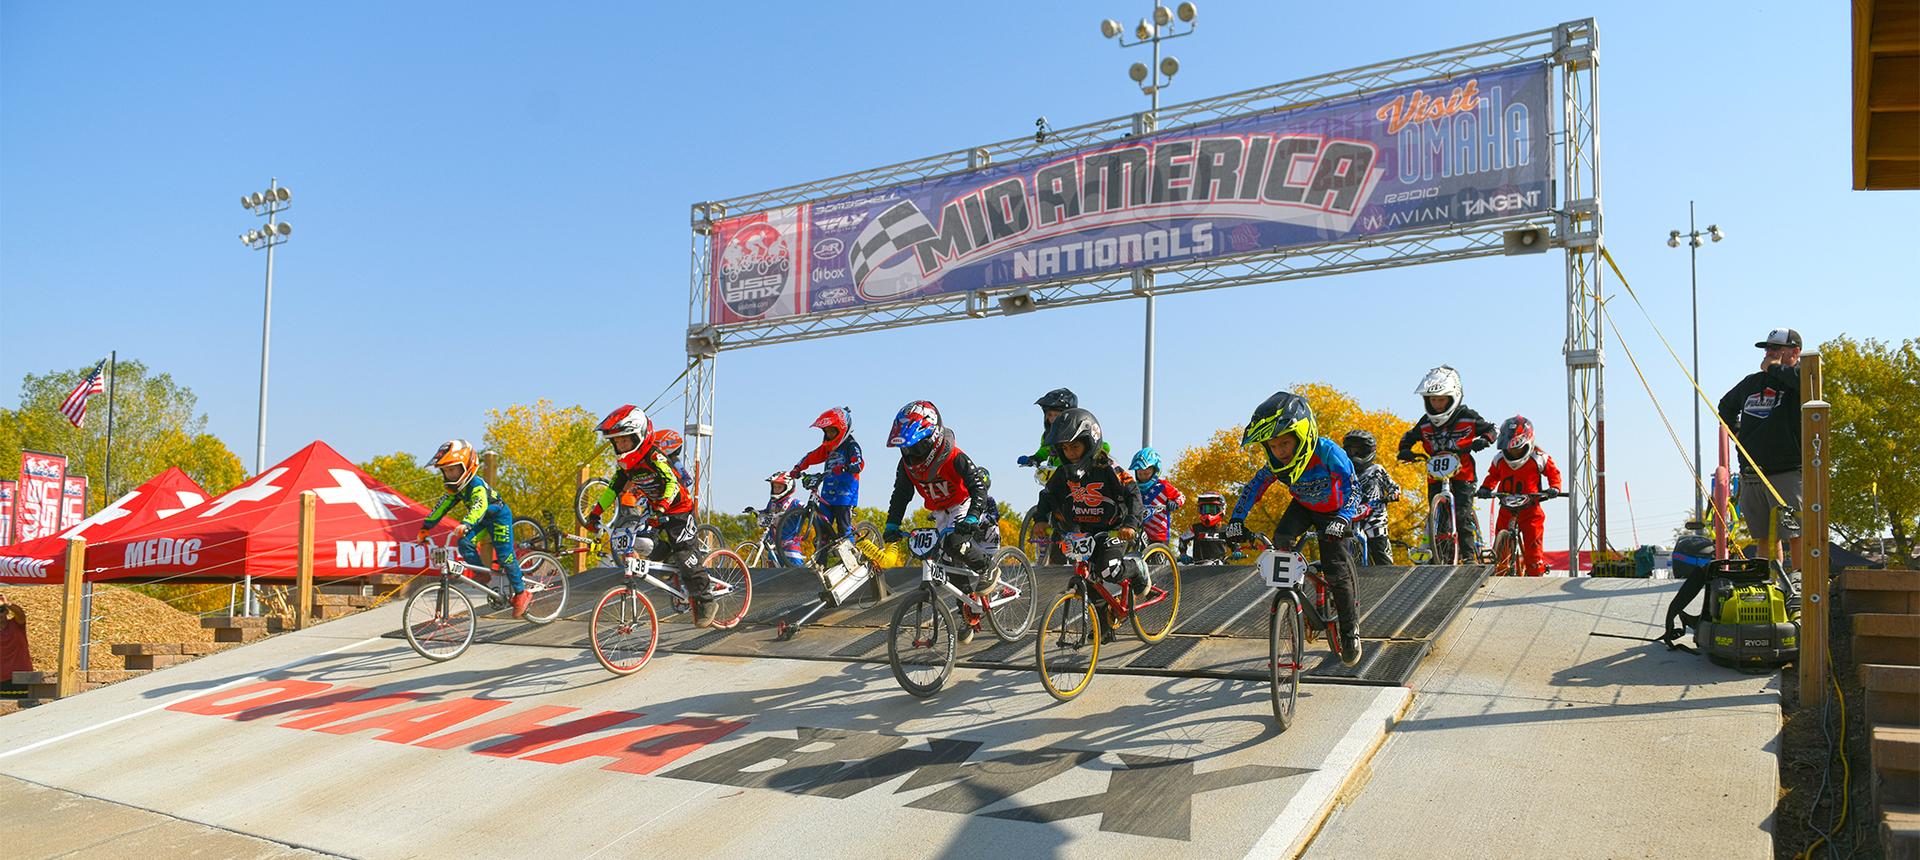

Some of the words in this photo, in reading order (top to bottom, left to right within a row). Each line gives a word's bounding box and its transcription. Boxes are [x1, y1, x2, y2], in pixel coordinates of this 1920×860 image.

[1376, 79, 1480, 134] Visit
[1397, 86, 1530, 184] OMAHA
[911, 174, 1034, 279] MID
[1034, 134, 1378, 230] AMERICA
[1462, 191, 1541, 216] TANGENT
[1389, 205, 1449, 226] AVIAN
[1013, 222, 1214, 279] NATIONALS
[726, 273, 782, 292] USA
[824, 267, 846, 280] box
[726, 285, 781, 303] BMX
[1433, 458, 1449, 472] 89
[617, 535, 629, 548] 38
[914, 532, 933, 549] 105
[124, 538, 201, 569] MEDIC
[335, 540, 457, 569] MED
[635, 558, 646, 573] 38
[1273, 556, 1291, 583] E
[1745, 639, 1769, 647] RYOBI
[163, 680, 750, 775] OMAHA
[656, 726, 1322, 841] BMX
